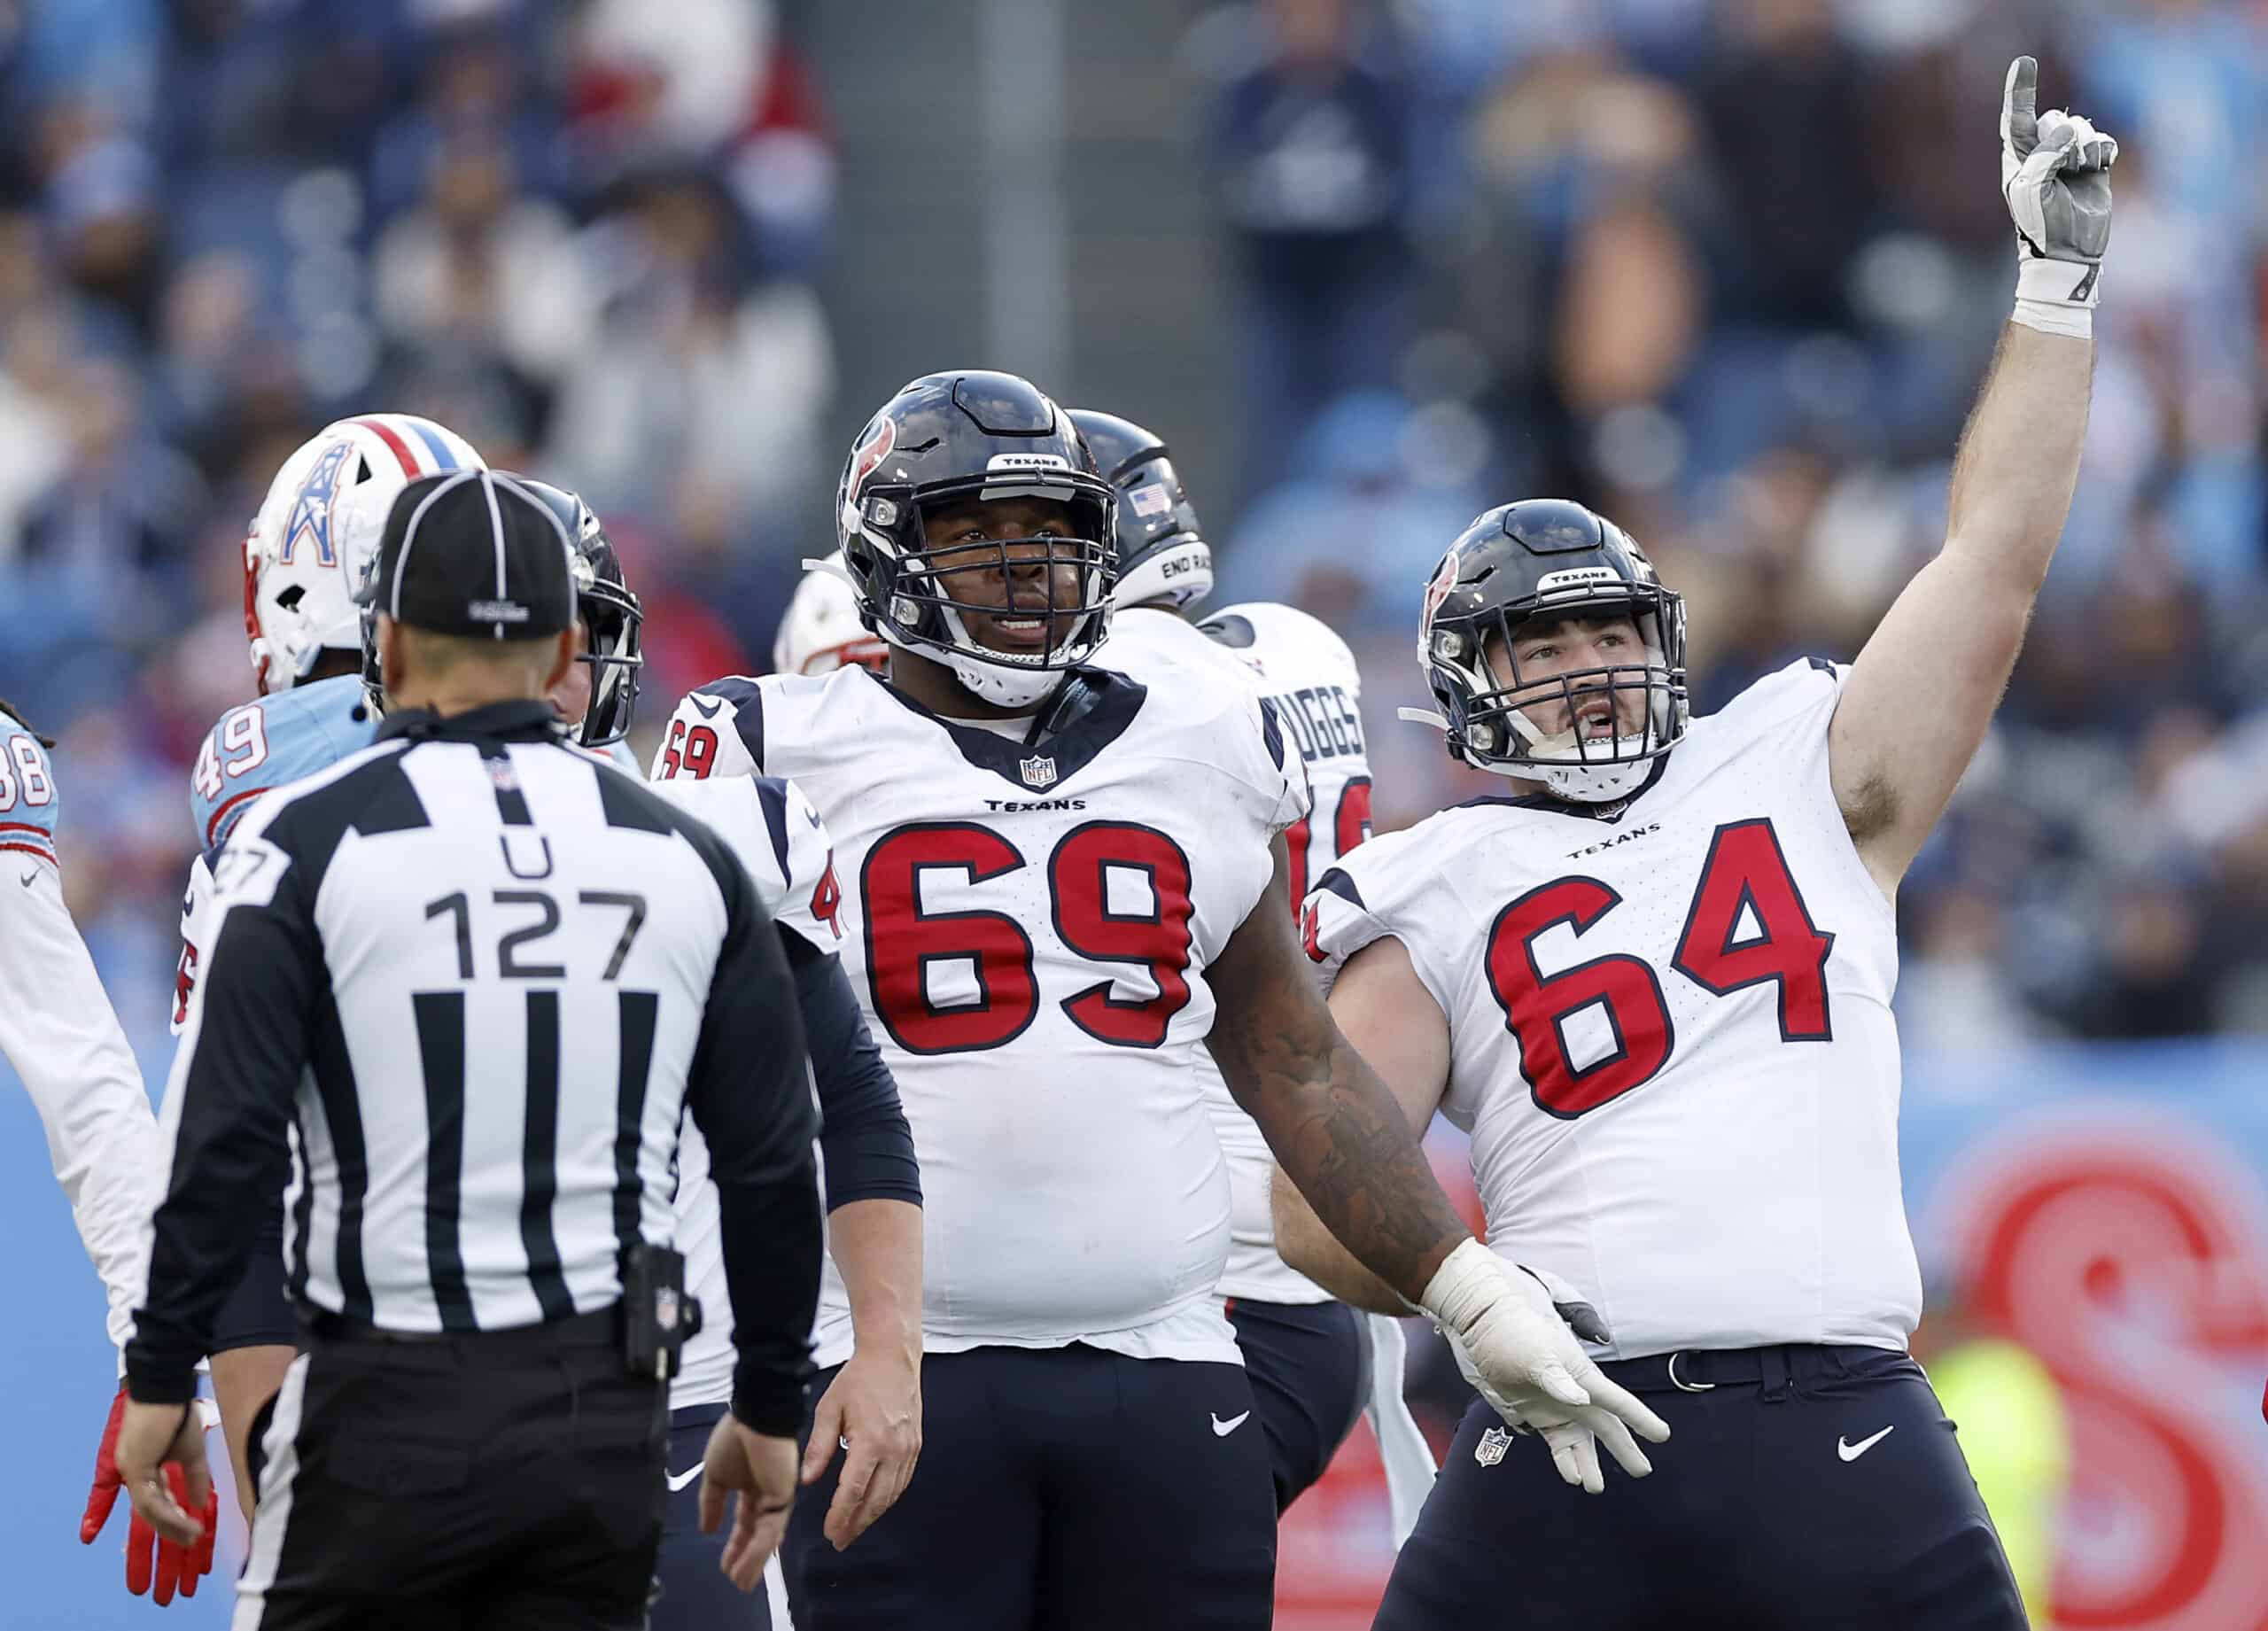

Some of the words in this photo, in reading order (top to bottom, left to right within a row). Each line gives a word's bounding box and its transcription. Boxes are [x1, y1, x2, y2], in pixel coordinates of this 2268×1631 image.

[1161, 556, 1191, 579] END
[1550, 571, 1608, 583] TEXANS
[194, 704, 269, 803] 49
[658, 718, 718, 780] 69
[1274, 685, 1363, 762] UGGS
[983, 799, 1086, 812] TEXANS
[499, 834, 554, 880] U
[1565, 822, 1661, 858] TEXANS
[424, 889, 648, 981] 127
[859, 820, 1192, 1056] 69
[1486, 817, 1836, 1120] 64
